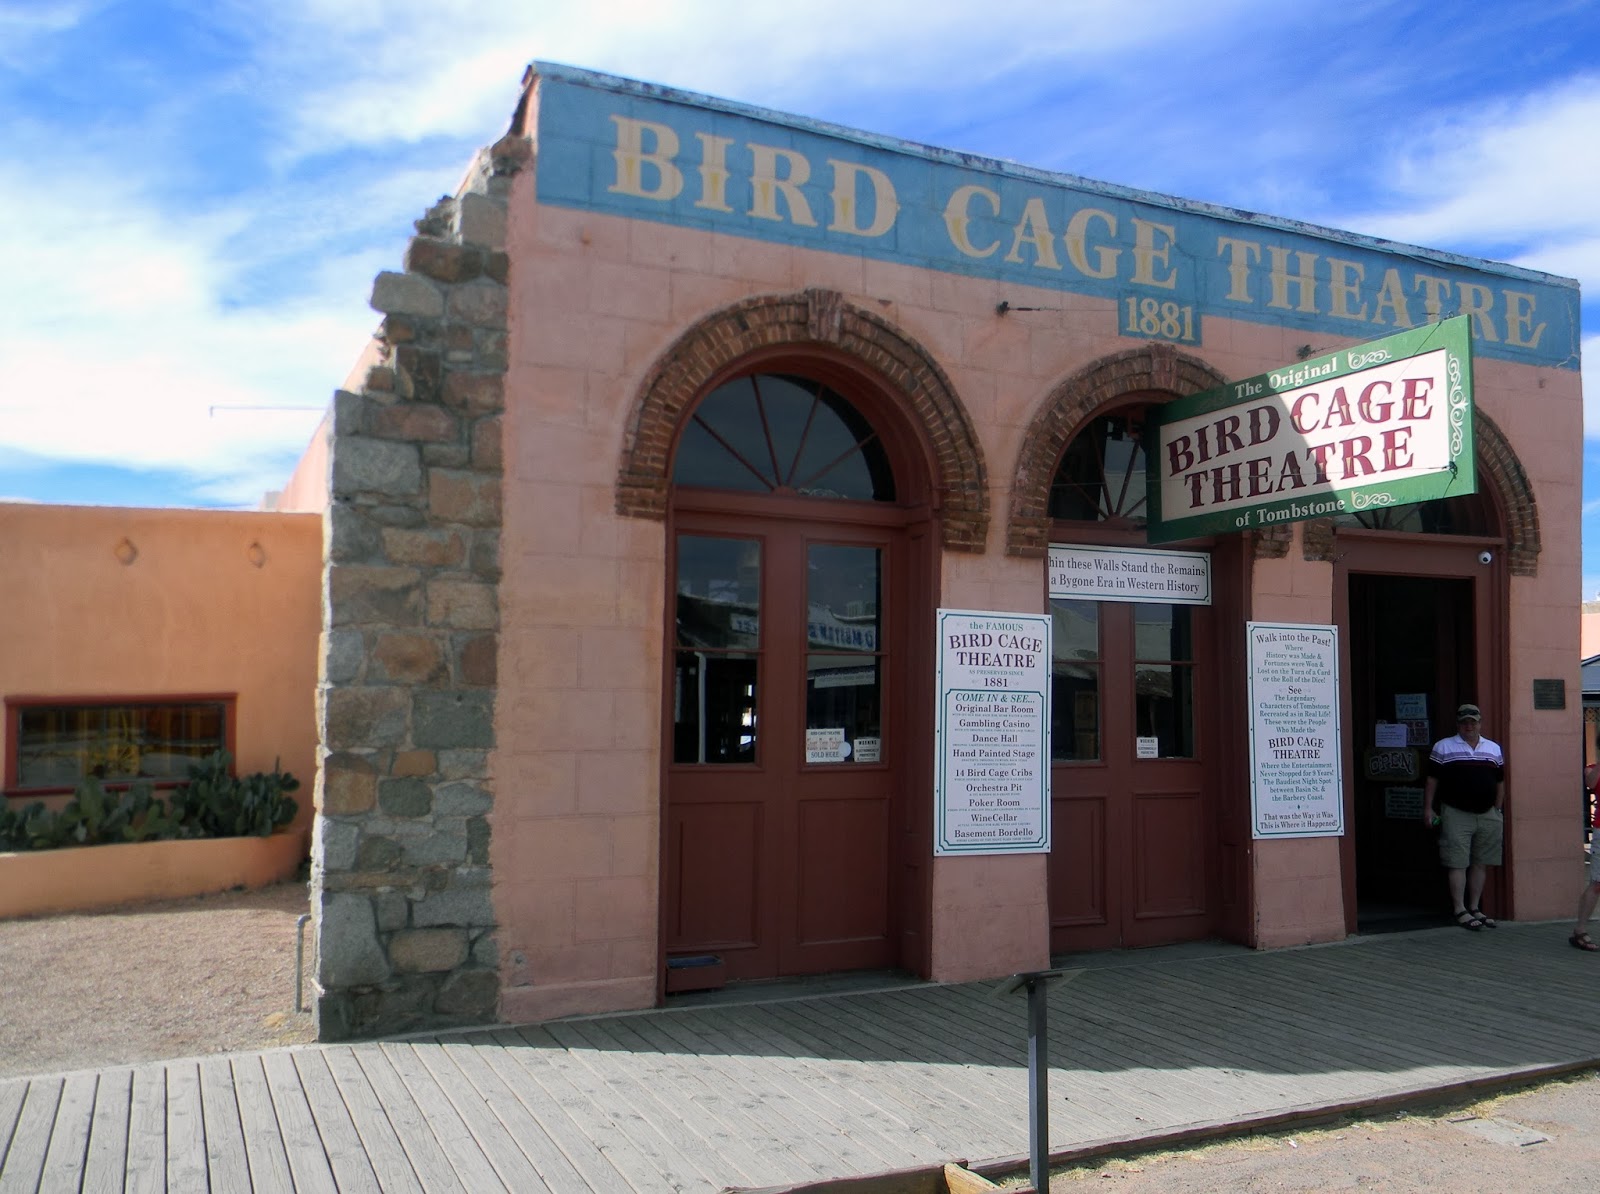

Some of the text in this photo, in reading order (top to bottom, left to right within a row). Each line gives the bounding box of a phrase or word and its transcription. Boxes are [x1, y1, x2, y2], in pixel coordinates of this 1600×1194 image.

[608, 114, 1546, 348] BIRD CAGE THEATRE
[1125, 296, 1193, 340] 1881
[1235, 356, 1338, 400] The Original
[1166, 377, 1434, 477] BIRD CAGE
[1184, 426, 1414, 509] THEATRE
[1235, 498, 1346, 528] of Tombstone
[1067, 558, 1092, 570] these
[1094, 558, 1119, 571] Walls
[1122, 560, 1148, 573] Stand
[1150, 562, 1165, 574] the
[1168, 563, 1205, 577] Remains
[1051, 574, 1200, 594] a Bygone Era in Western History
[970, 622, 1024, 631] the FAMOUS
[949, 634, 1042, 653] BIRD CAGE
[1256, 633, 1331, 647] Walk into the Past!
[956, 652, 1035, 668] THEATRE
[984, 678, 1008, 687] 1881
[1288, 685, 1302, 694] See
[956, 693, 985, 702] COME
[987, 694, 998, 702] IN
[1000, 694, 1007, 702] &
[956, 704, 1034, 713] Original Bar Room
[959, 719, 1030, 728] Gambling Casino
[972, 734, 1018, 743] Dance Hall
[1269, 736, 1324, 748] BIRD CAGE
[953, 749, 1035, 758] Hand Painted Stage
[1273, 750, 1320, 759] THEATRE
[1369, 751, 1414, 775] OPEN
[967, 769, 986, 777] Bird
[988, 769, 1009, 778] Cage
[1011, 769, 1033, 777] Cribs
[966, 784, 1008, 792] Orchestra
[969, 799, 994, 807] Poker
[954, 828, 1033, 838] Basement Bordello
